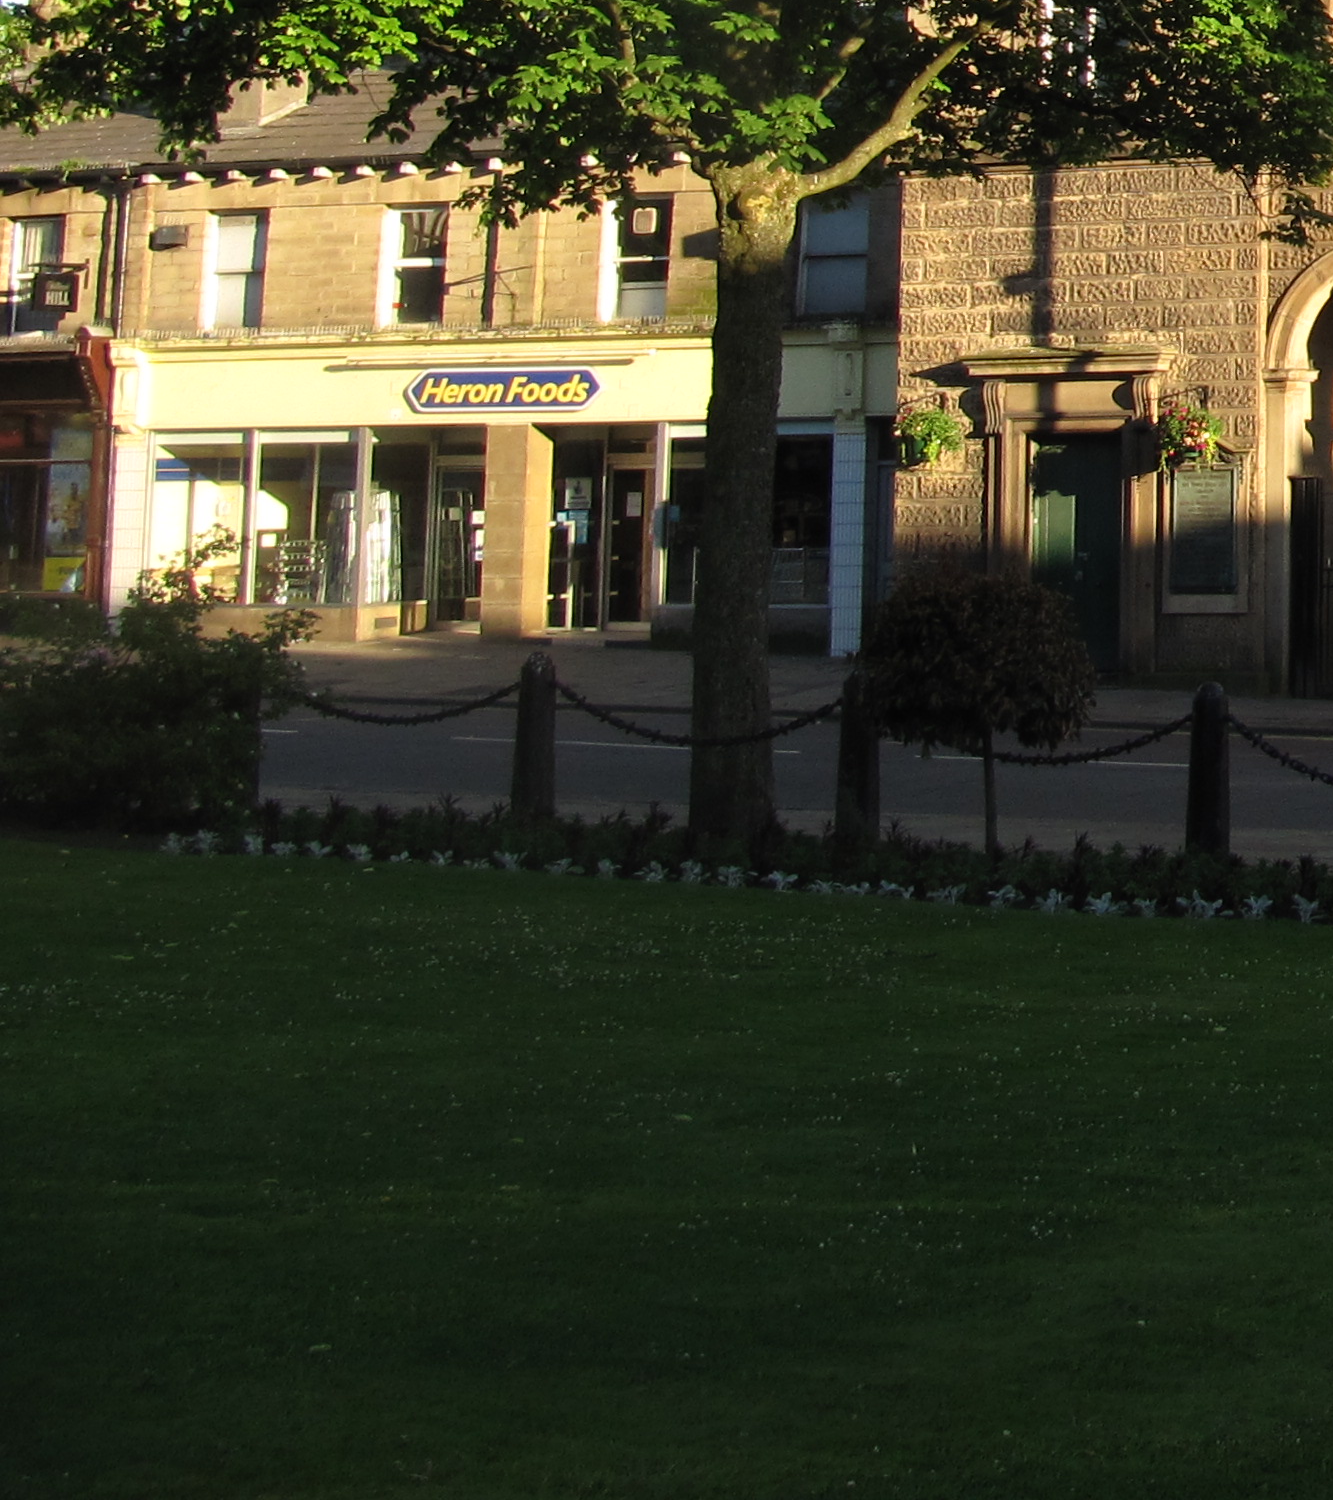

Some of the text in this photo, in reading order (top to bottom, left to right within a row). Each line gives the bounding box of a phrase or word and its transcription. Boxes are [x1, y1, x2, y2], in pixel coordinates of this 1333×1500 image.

[45, 291, 69, 306] HILL
[419, 374, 589, 404] Heron Foods
